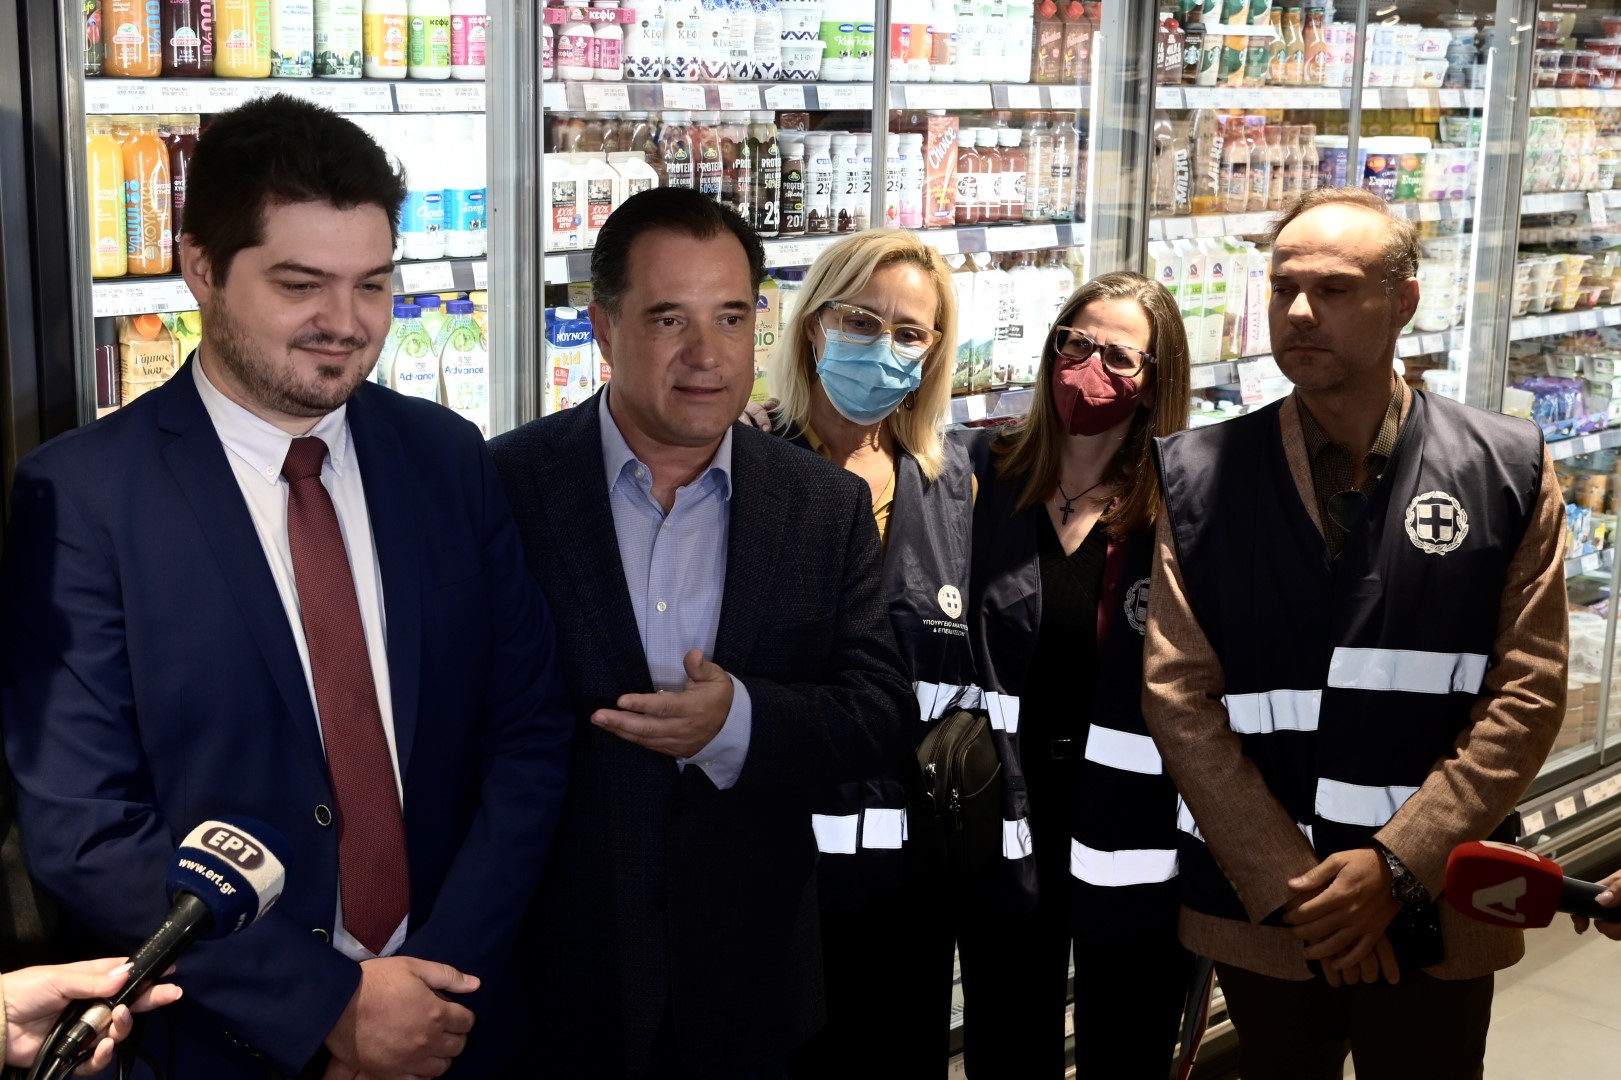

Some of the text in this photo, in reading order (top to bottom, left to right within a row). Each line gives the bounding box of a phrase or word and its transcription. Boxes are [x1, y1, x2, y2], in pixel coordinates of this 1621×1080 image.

[429, 18, 449, 27] κεφίρ
[589, 10, 616, 22] κεφίρ
[928, 125, 957, 170] Choice
[1174, 148, 1189, 205] MILKO
[562, 350, 581, 366] kid
[399, 372, 436, 381] Advance
[444, 366, 484, 375] Advance
[922, 619, 952, 627] ΥΠΟΥΡΓΕΙΟ
[207, 830, 258, 863] ΕΡΤ
[178, 858, 237, 896] www.ert.gr
